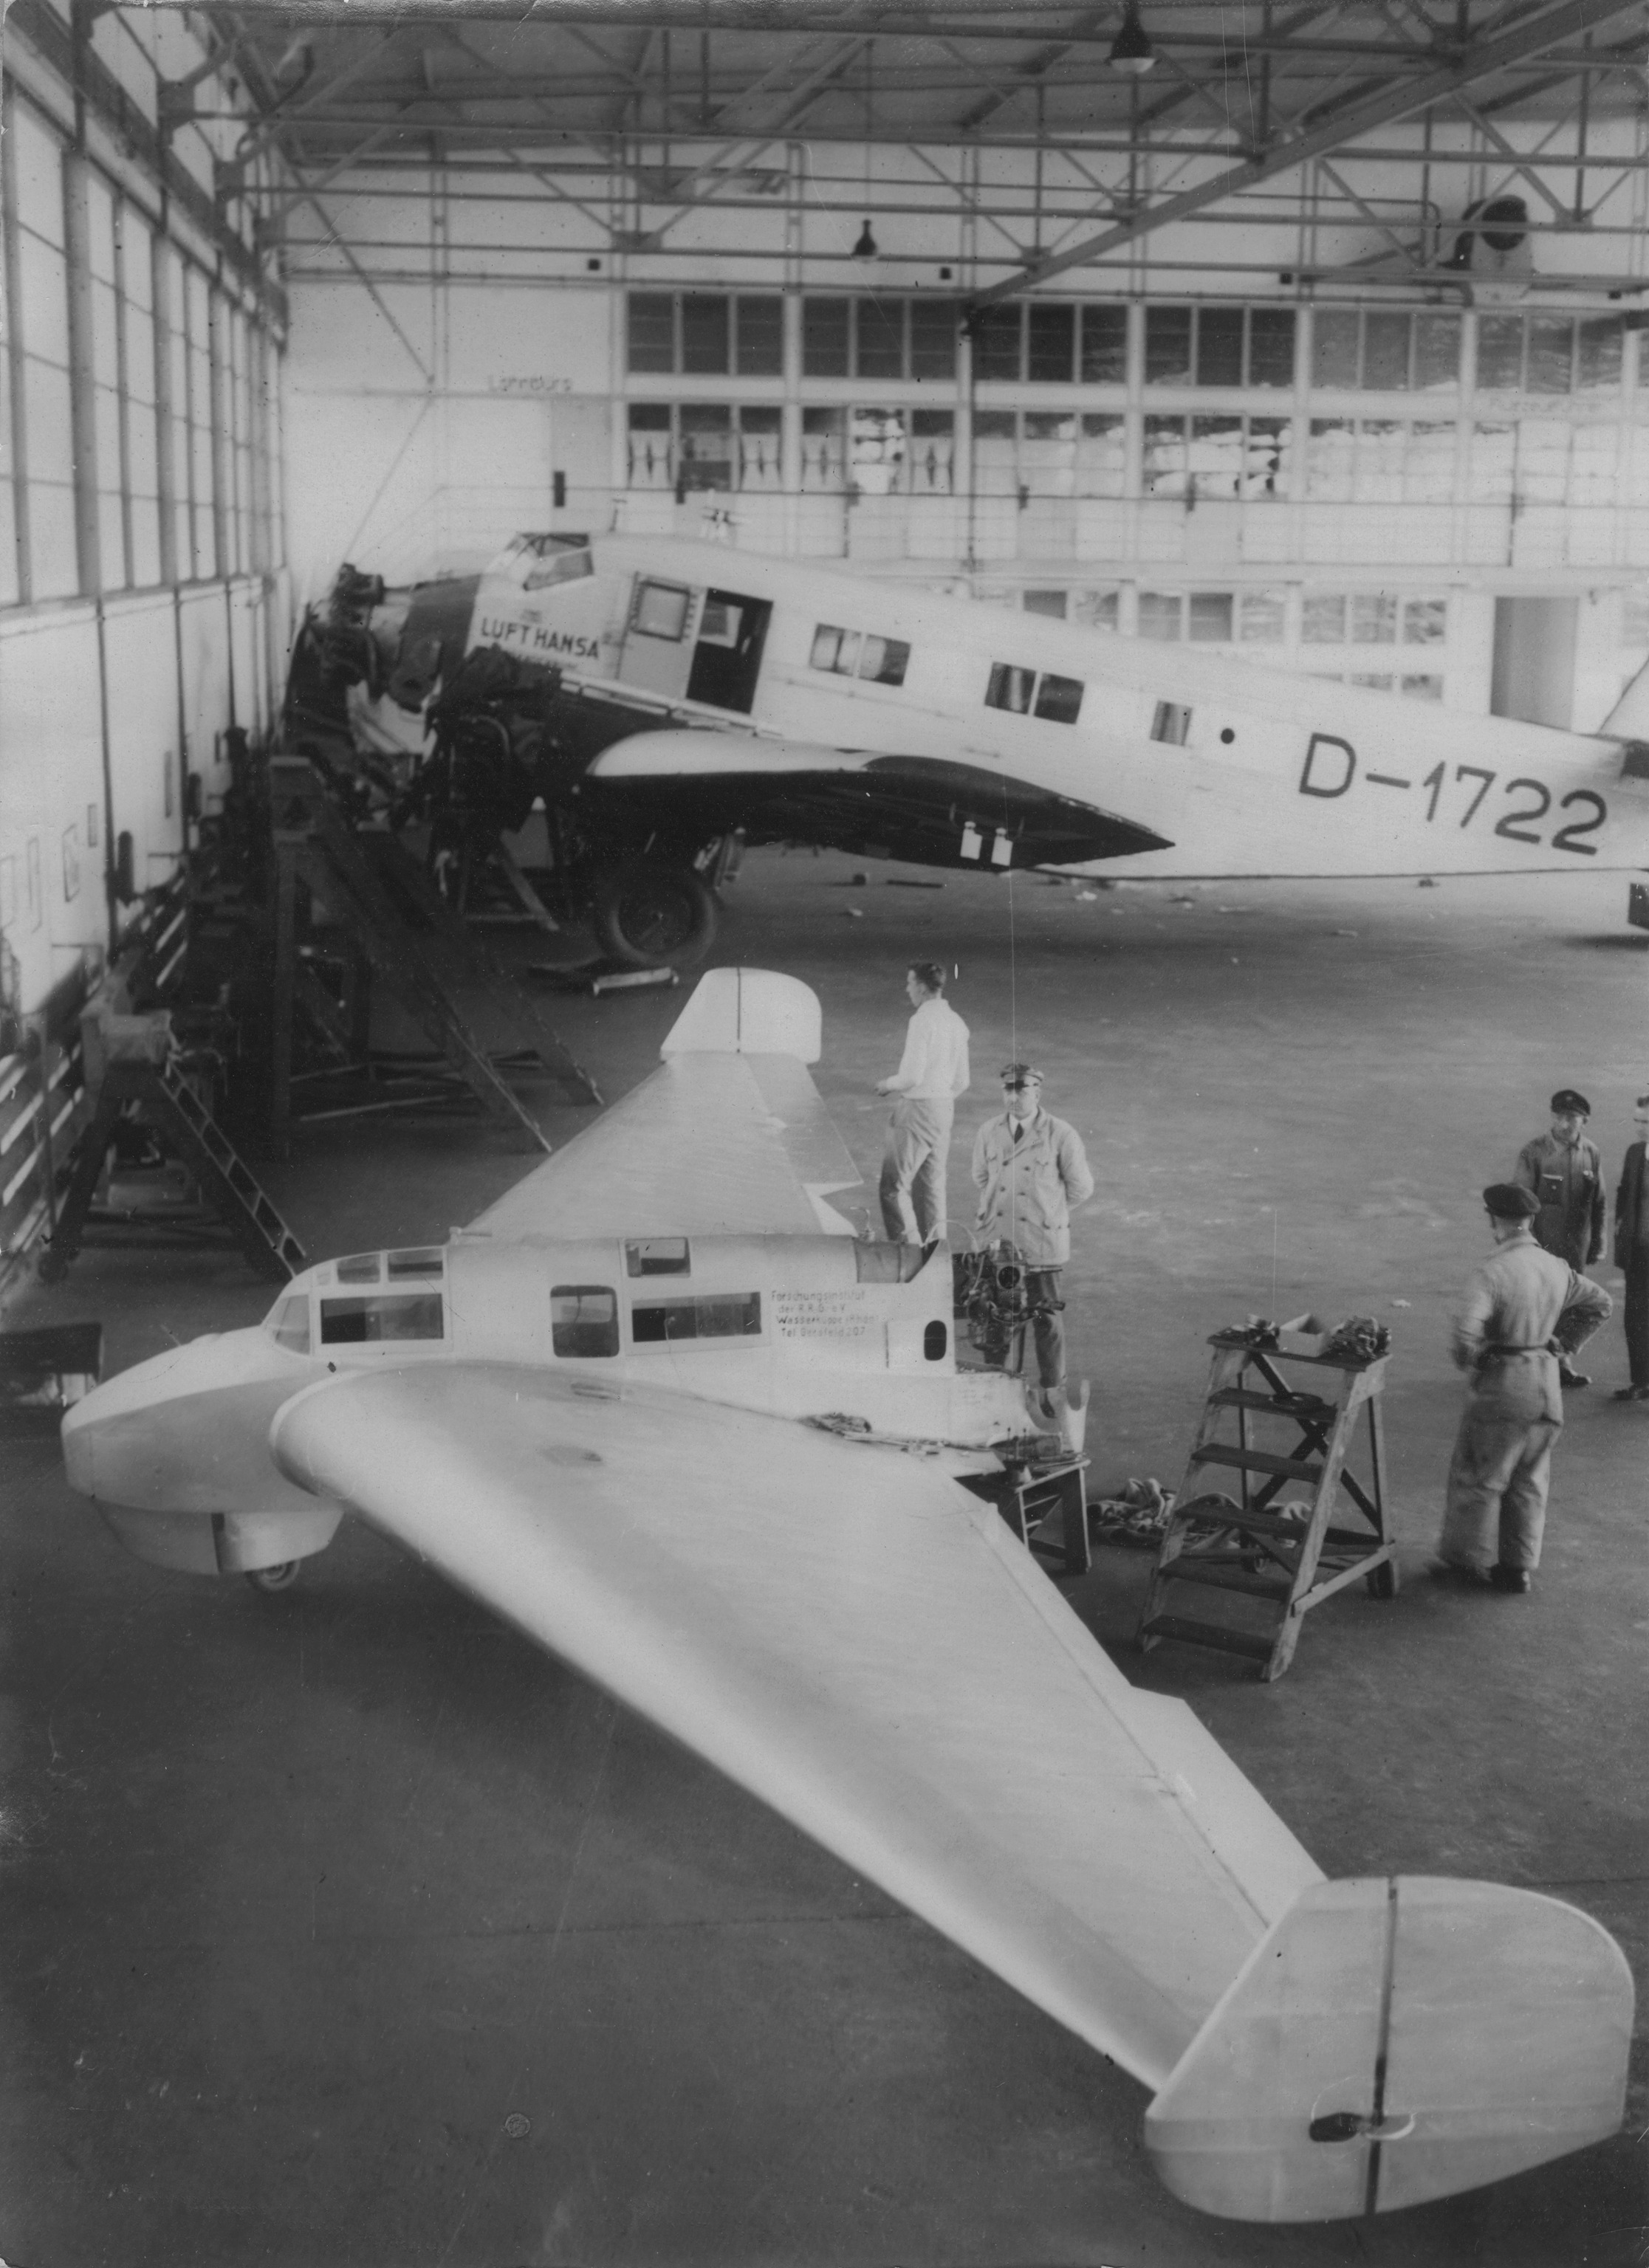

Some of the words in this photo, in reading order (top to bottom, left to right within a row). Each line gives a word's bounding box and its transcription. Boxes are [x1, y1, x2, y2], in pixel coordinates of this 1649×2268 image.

[481, 617, 530, 644] LUFT
[534, 629, 600, 659] HANSA
[1299, 732, 1608, 856] D-1722
